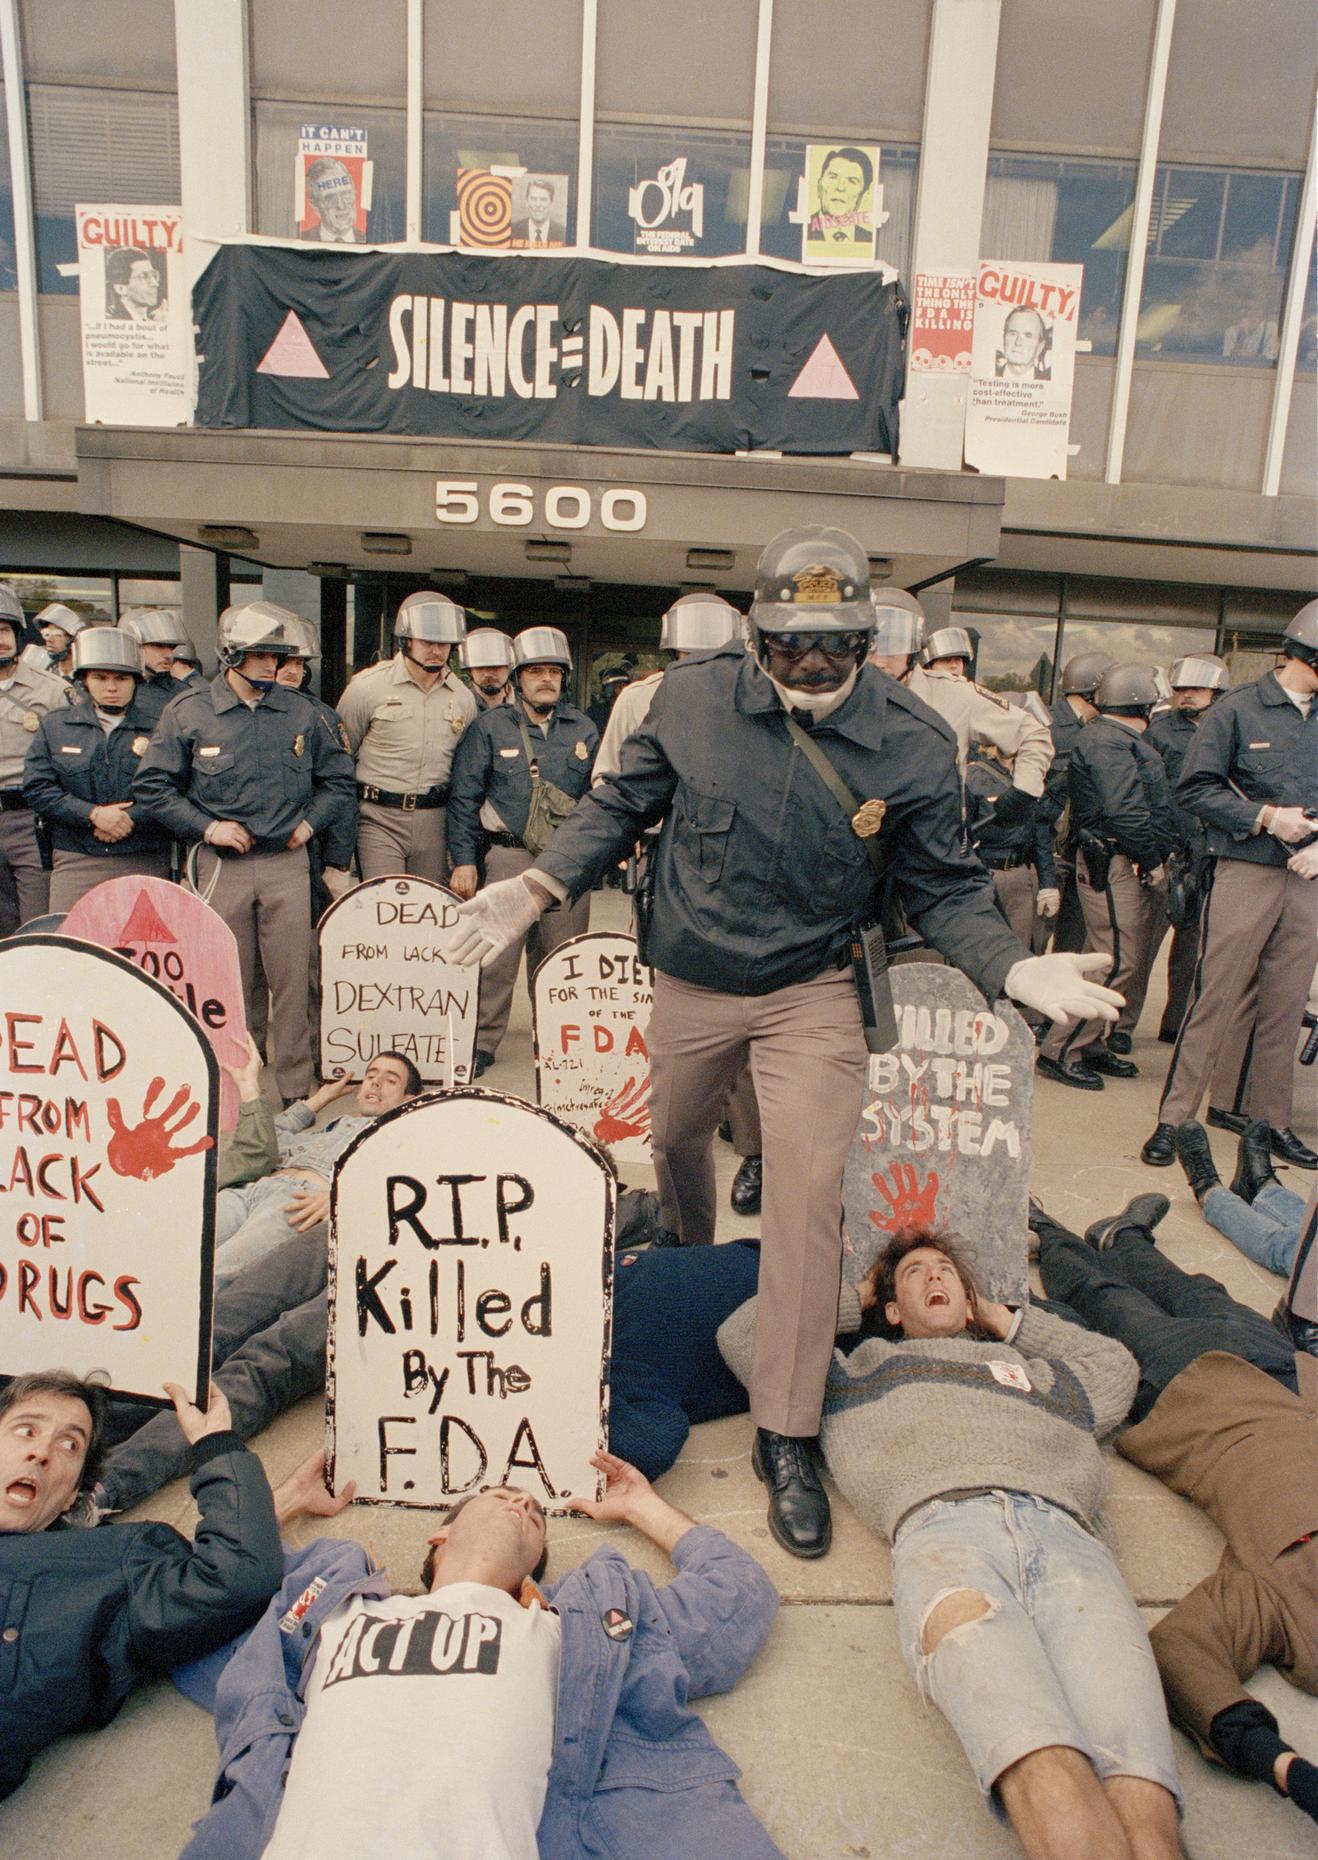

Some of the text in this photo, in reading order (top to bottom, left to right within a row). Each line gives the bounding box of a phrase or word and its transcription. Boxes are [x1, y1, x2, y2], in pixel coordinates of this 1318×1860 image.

[302, 127, 363, 141] IT CAN'T
[302, 142, 363, 154] HAPPEN
[317, 176, 349, 192] HERE
[82, 217, 178, 250] GUILTY
[917, 276, 976, 289] TIME ISN'T
[978, 270, 1075, 315] GUILTY
[916, 297, 974, 309] THING THE
[917, 287, 975, 299] THE ONLY
[915, 318, 973, 331] KILLING
[960, 309, 973, 320] IS
[109, 323, 126, 331] had
[136, 324, 157, 332] bout
[159, 324, 168, 332] of
[91, 341, 116, 349] would
[147, 343, 170, 351] what
[95, 350, 134, 358] available
[150, 351, 165, 359] the
[114, 377, 146, 385] National
[973, 389, 1033, 399] cost-effective
[985, 415, 1067, 426] Presidential Candidate
[1021, 410, 1048, 418] George
[436, 480, 647, 532] 5600
[376, 902, 460, 928] DEAD
[341, 943, 448, 965] FROM LACK
[561, 954, 584, 981] I
[333, 980, 469, 1020] DEXTRAN
[548, 986, 579, 1004] FOR
[585, 986, 620, 1001] THE
[588, 1009, 637, 1020] OF THE
[0, 1011, 126, 1083] EAD
[868, 1053, 1012, 1107] BY THE
[0, 1090, 91, 1143] FROM
[861, 1100, 1022, 1159] SYSTEM
[0, 1146, 105, 1213] ACK
[16, 1212, 66, 1249] OF
[355, 1254, 553, 1343] Killed
[402, 1348, 533, 1415] By The
[377, 1415, 573, 1500] F.D.A.
[325, 1611, 499, 1686] ACT UP
